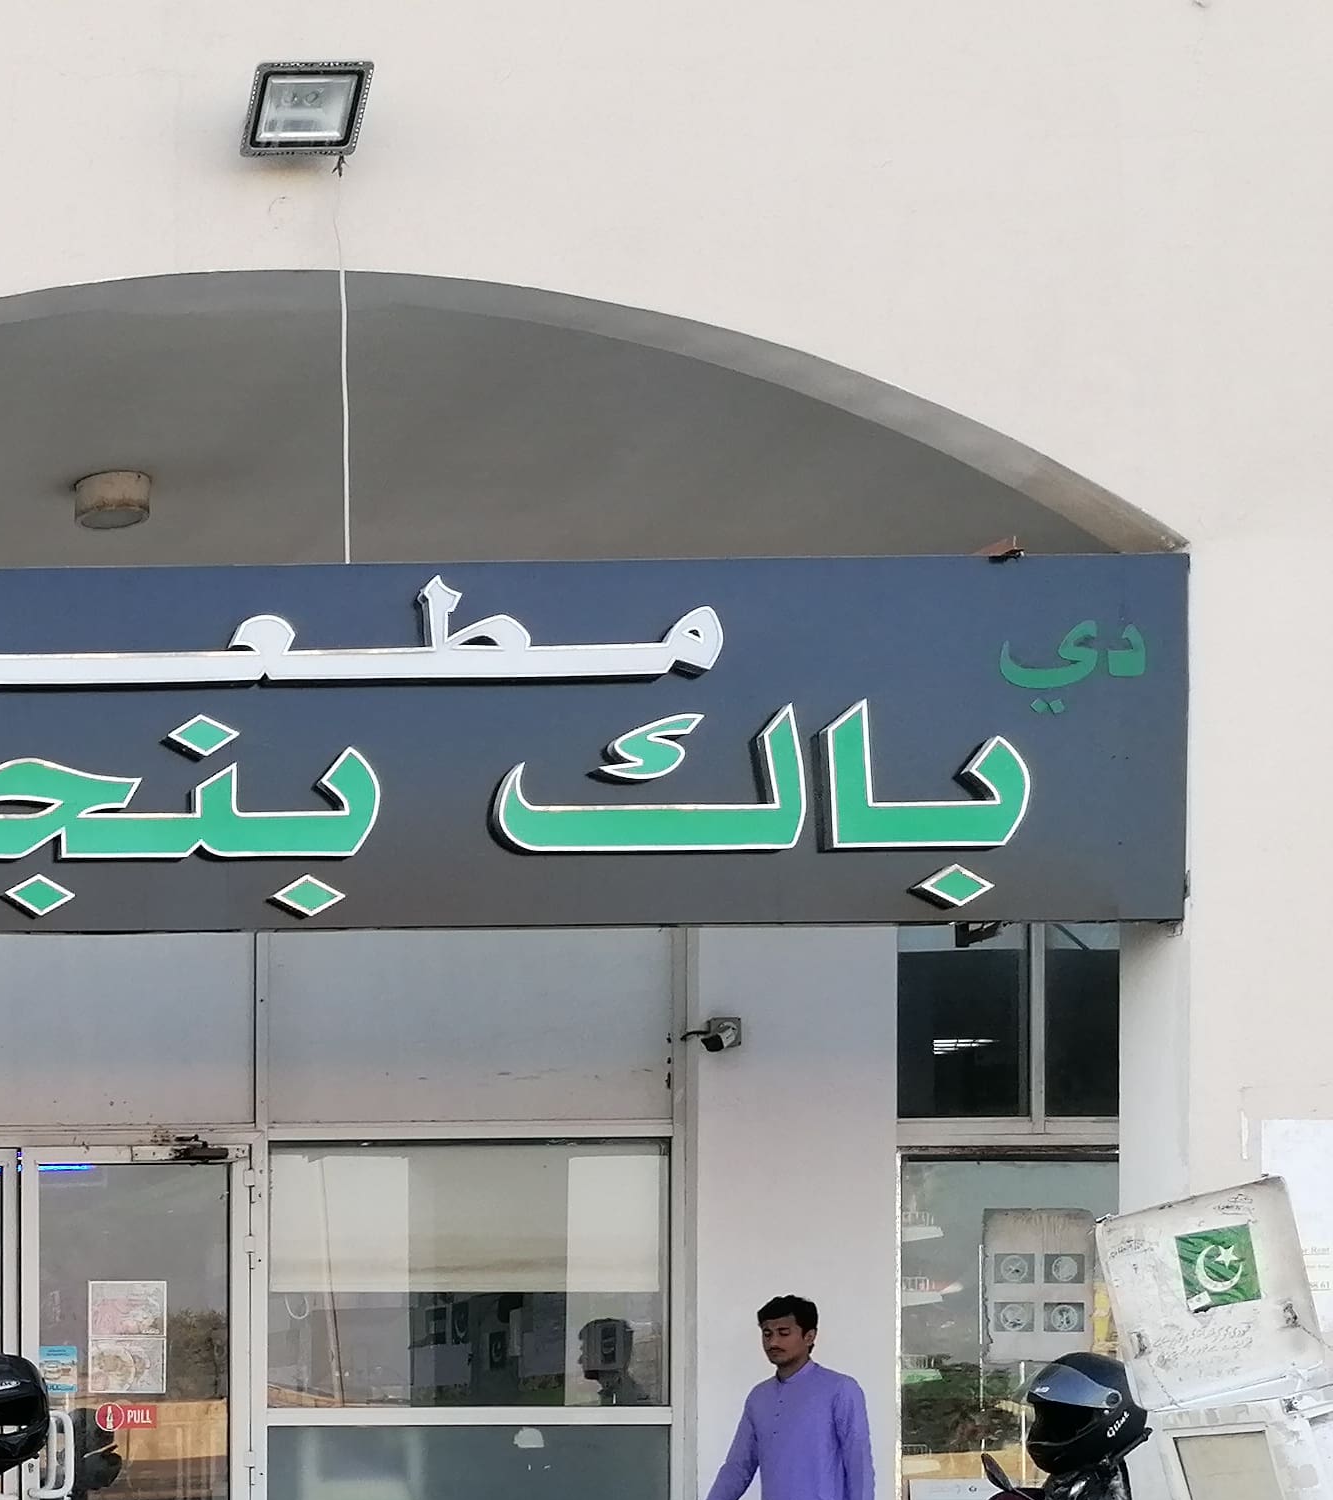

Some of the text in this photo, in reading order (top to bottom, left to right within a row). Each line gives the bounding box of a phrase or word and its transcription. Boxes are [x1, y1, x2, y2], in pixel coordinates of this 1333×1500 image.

[999, 618, 1147, 714] دي
[495, 697, 1031, 907] باك
[127, 1409, 152, 1423] PULL
